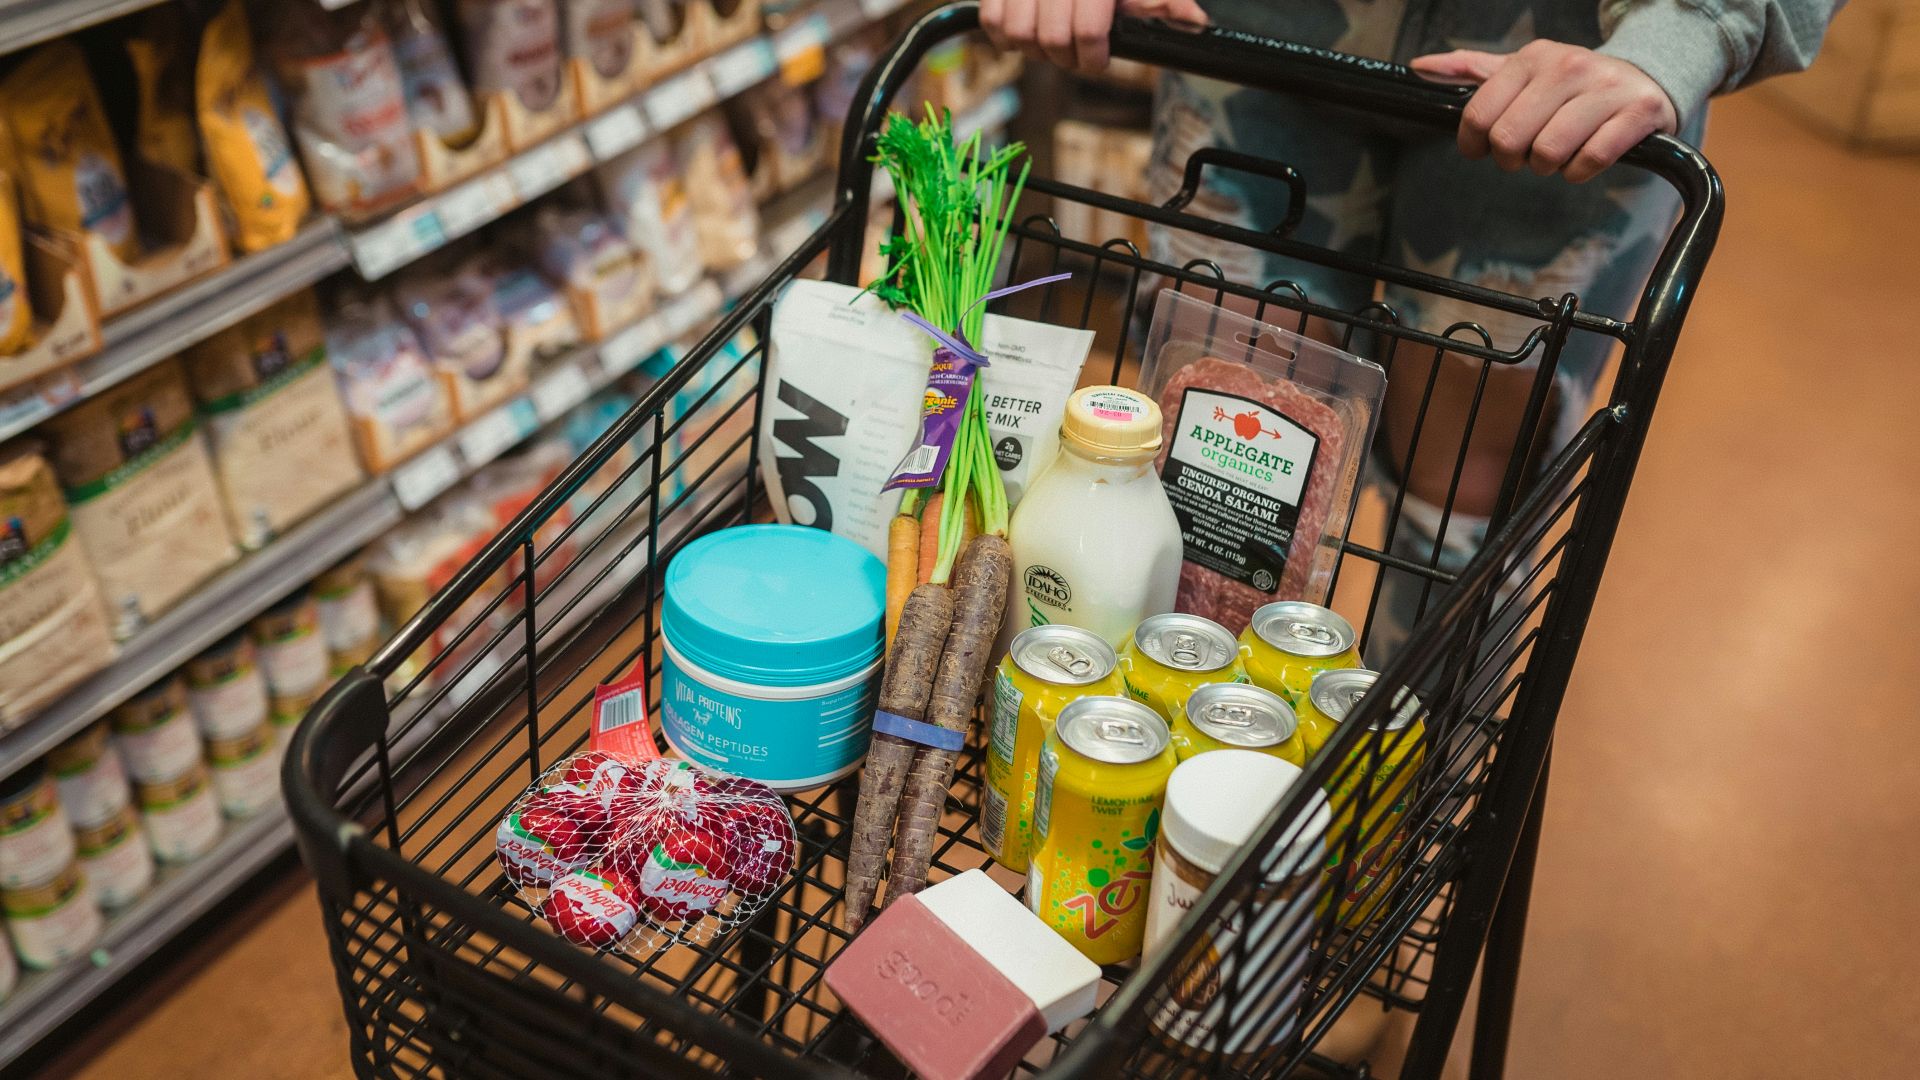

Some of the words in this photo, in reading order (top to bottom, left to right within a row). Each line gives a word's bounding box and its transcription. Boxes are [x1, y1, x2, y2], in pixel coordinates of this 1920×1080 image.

[992, 396, 1042, 414] BETTER
[995, 413, 1022, 428] MIX
[1004, 442, 1014, 452] 2g
[1190, 425, 1294, 475] APPLEGATE
[1182, 465, 1230, 492] UNCURED
[1232, 487, 1281, 511] ORGANIC
[1177, 476, 1221, 502] GENOA
[1225, 495, 1279, 524] SALAMI
[1183, 532, 1195, 543] NET
[1196, 538, 1207, 548] WT.
[1214, 546, 1224, 555] OZ.
[1225, 551, 1246, 565] (113g)
[1028, 574, 1068, 600] IDAHO
[675, 677, 696, 703] VITAL
[698, 694, 742, 730] PROTEINS
[1130, 688, 1149, 701] LIME
[707, 735, 768, 757] PEPTIDES
[1092, 796, 1130, 806] LEMON
[1092, 806, 1124, 815] TWIST
